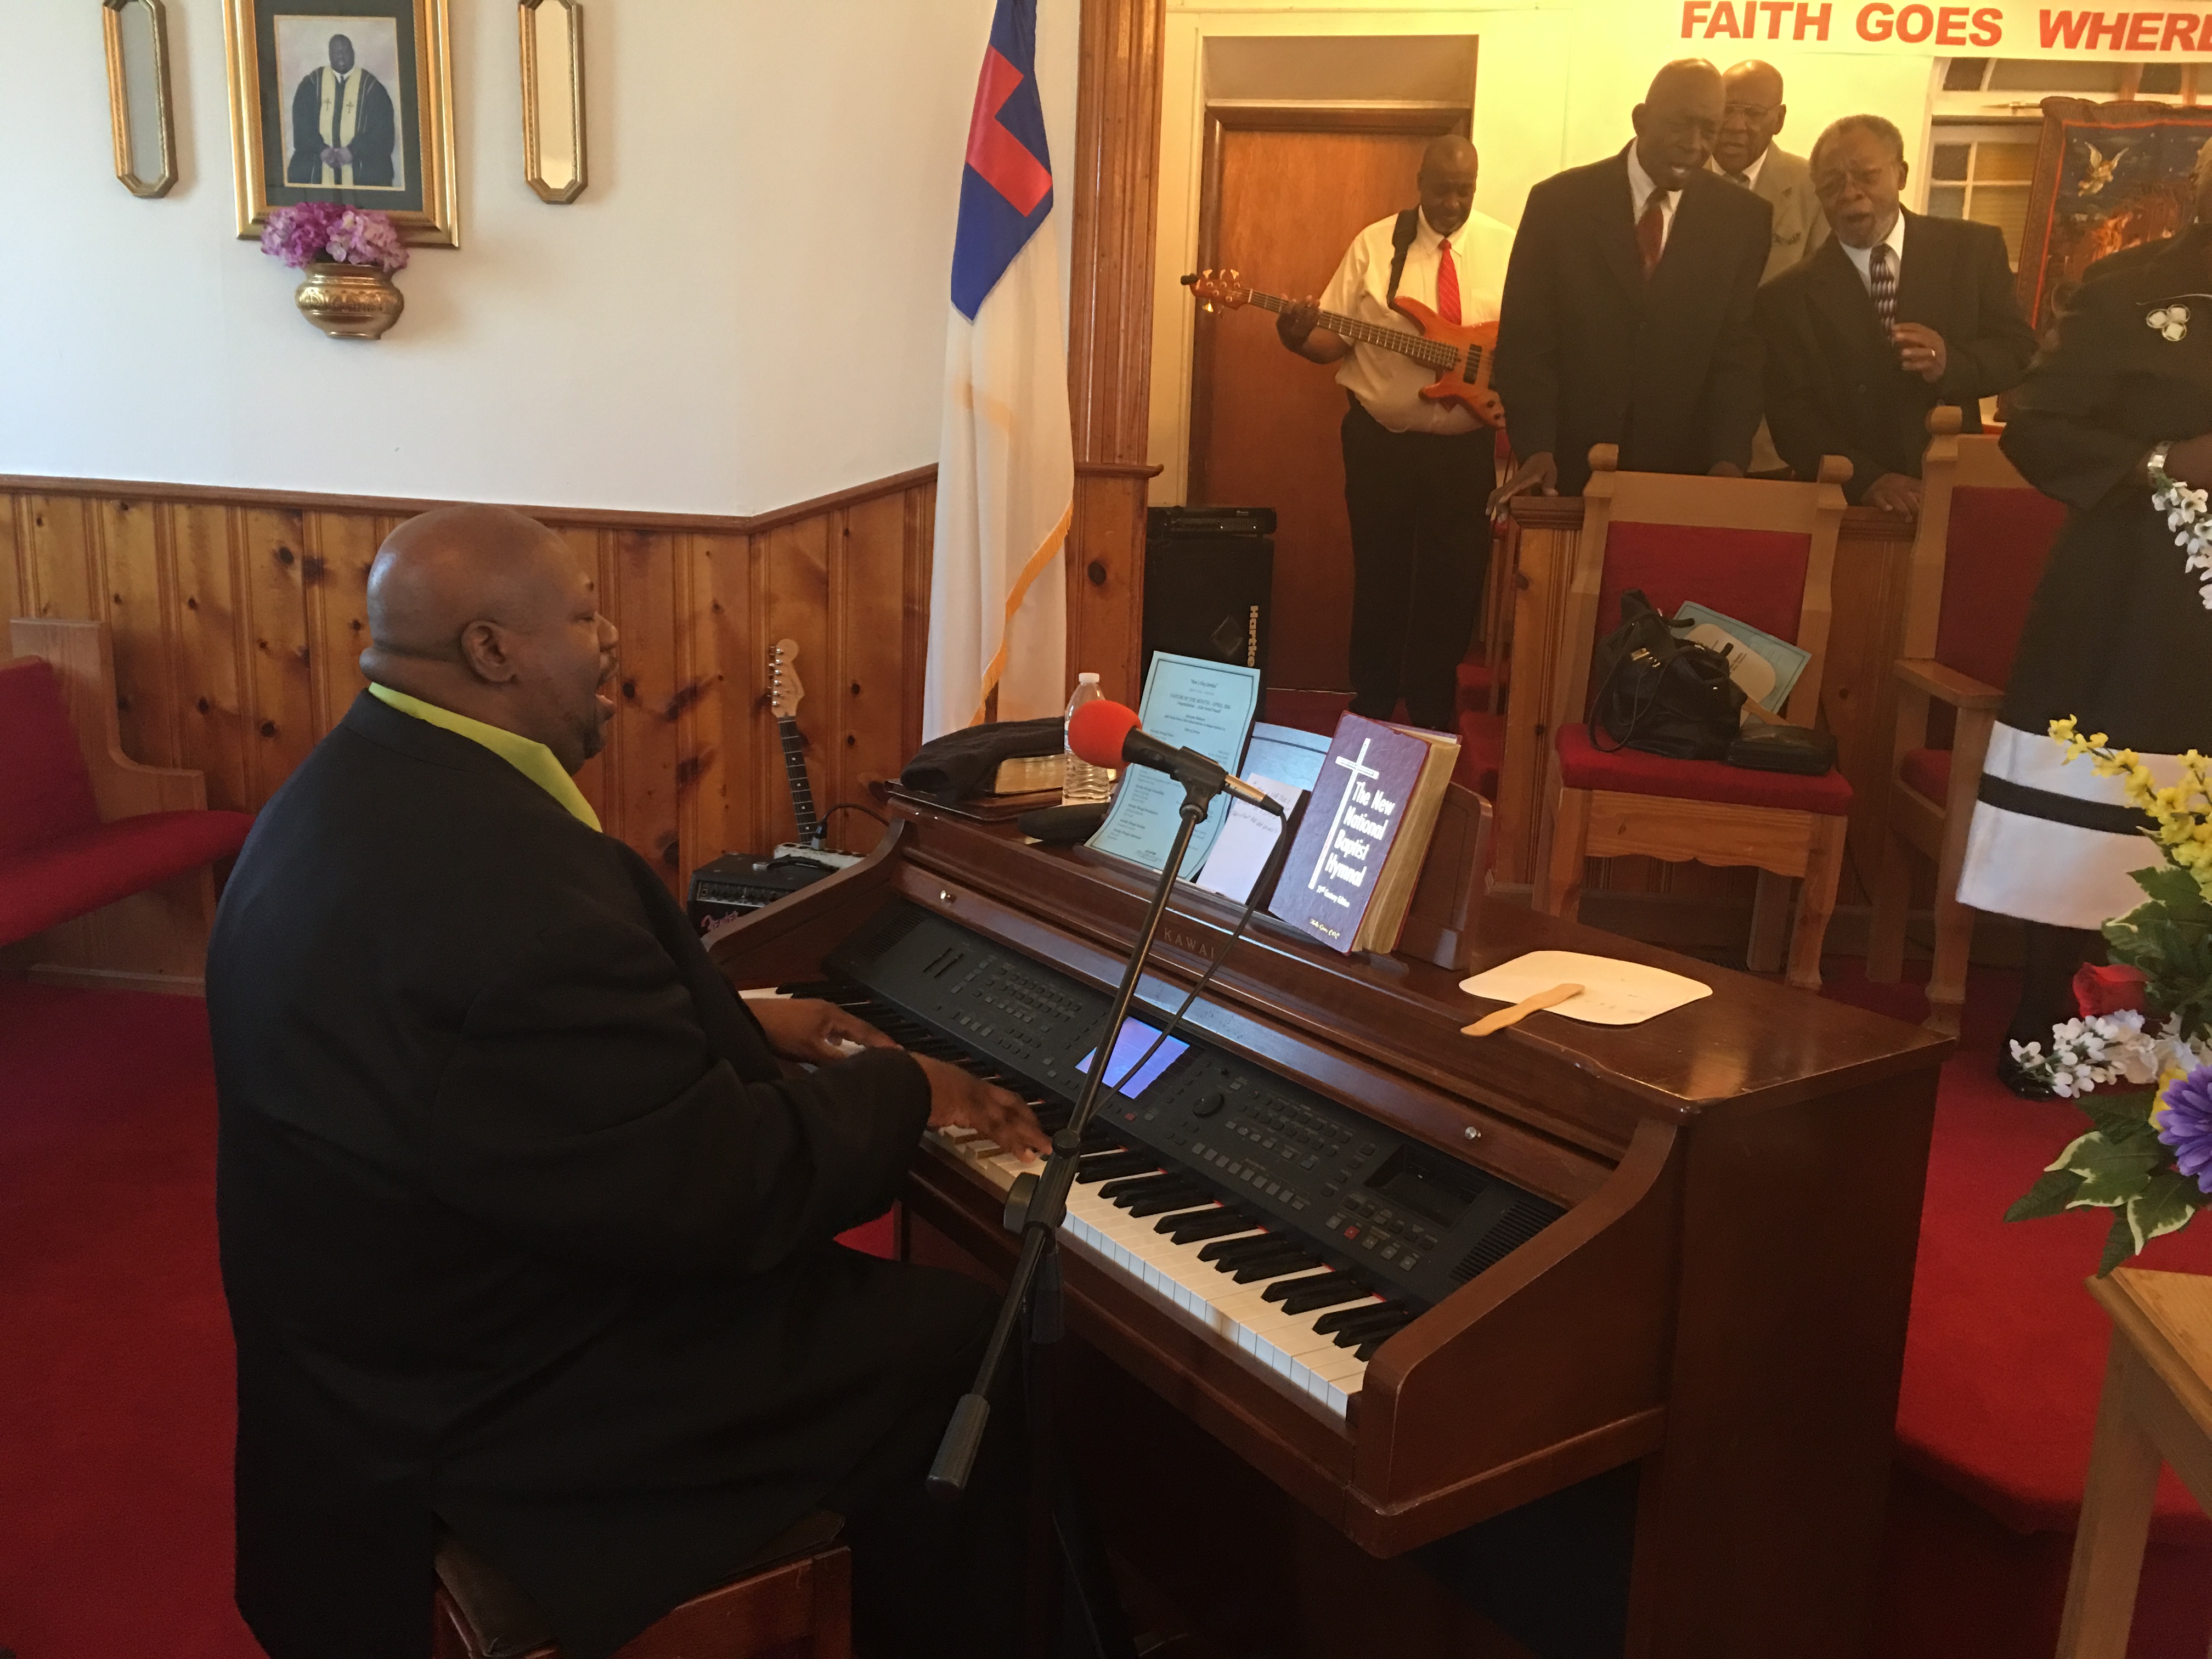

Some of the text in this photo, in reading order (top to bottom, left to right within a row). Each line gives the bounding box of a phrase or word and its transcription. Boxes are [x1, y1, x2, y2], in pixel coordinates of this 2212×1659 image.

[1680, 0, 1832, 41] FAITH
[1855, 2, 2004, 47] GOES
[1247, 605, 1259, 667] Hartke
[1352, 781, 1396, 816] The New
[1342, 805, 1389, 840] National
[1334, 829, 1370, 861] Baptist
[1324, 852, 1367, 887] Hymnal
[1164, 928, 1214, 959] KAWAI
